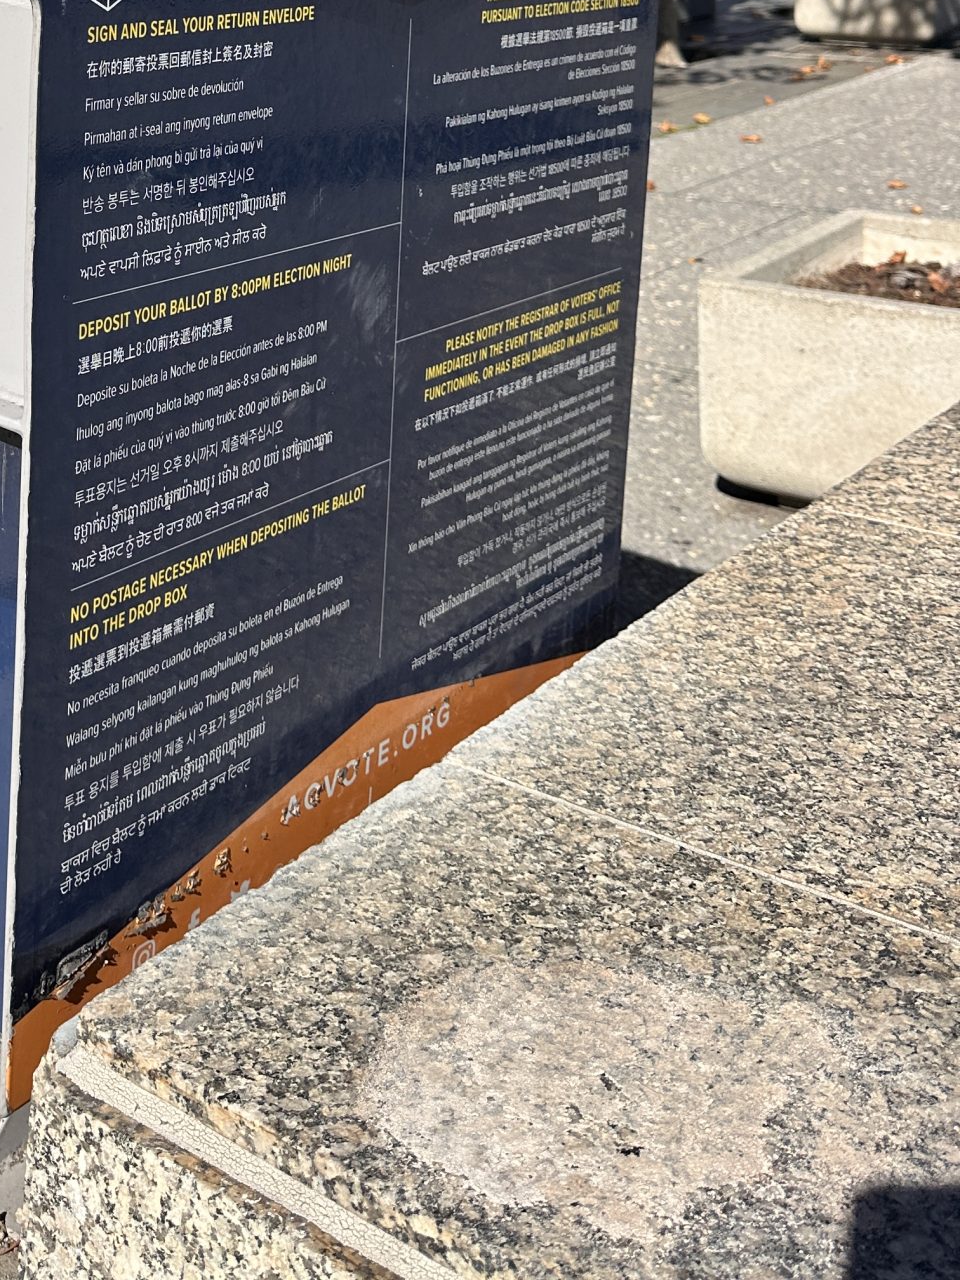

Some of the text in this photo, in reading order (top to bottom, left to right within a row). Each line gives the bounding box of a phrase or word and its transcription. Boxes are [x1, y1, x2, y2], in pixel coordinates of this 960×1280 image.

[87, 5, 314, 43] SIGN AND SEAL YOUR RETURN ENVELOPE
[481, 6, 522, 23] PURSUANT
[524, 4, 534, 19] TO
[534, 1, 569, 17] ELECTION
[85, 77, 244, 112] Firmar y sellar su sobre de devolución
[78, 253, 351, 340] DEPOSIT YOUR BALLOT BY 8:00PM ELECTION NIGHT
[70, 484, 365, 623] NO POSTAGE NECESSARY WHEN DEPOSITING THE BALLOT
[69, 583, 187, 650] INTO THE DROP BOX
